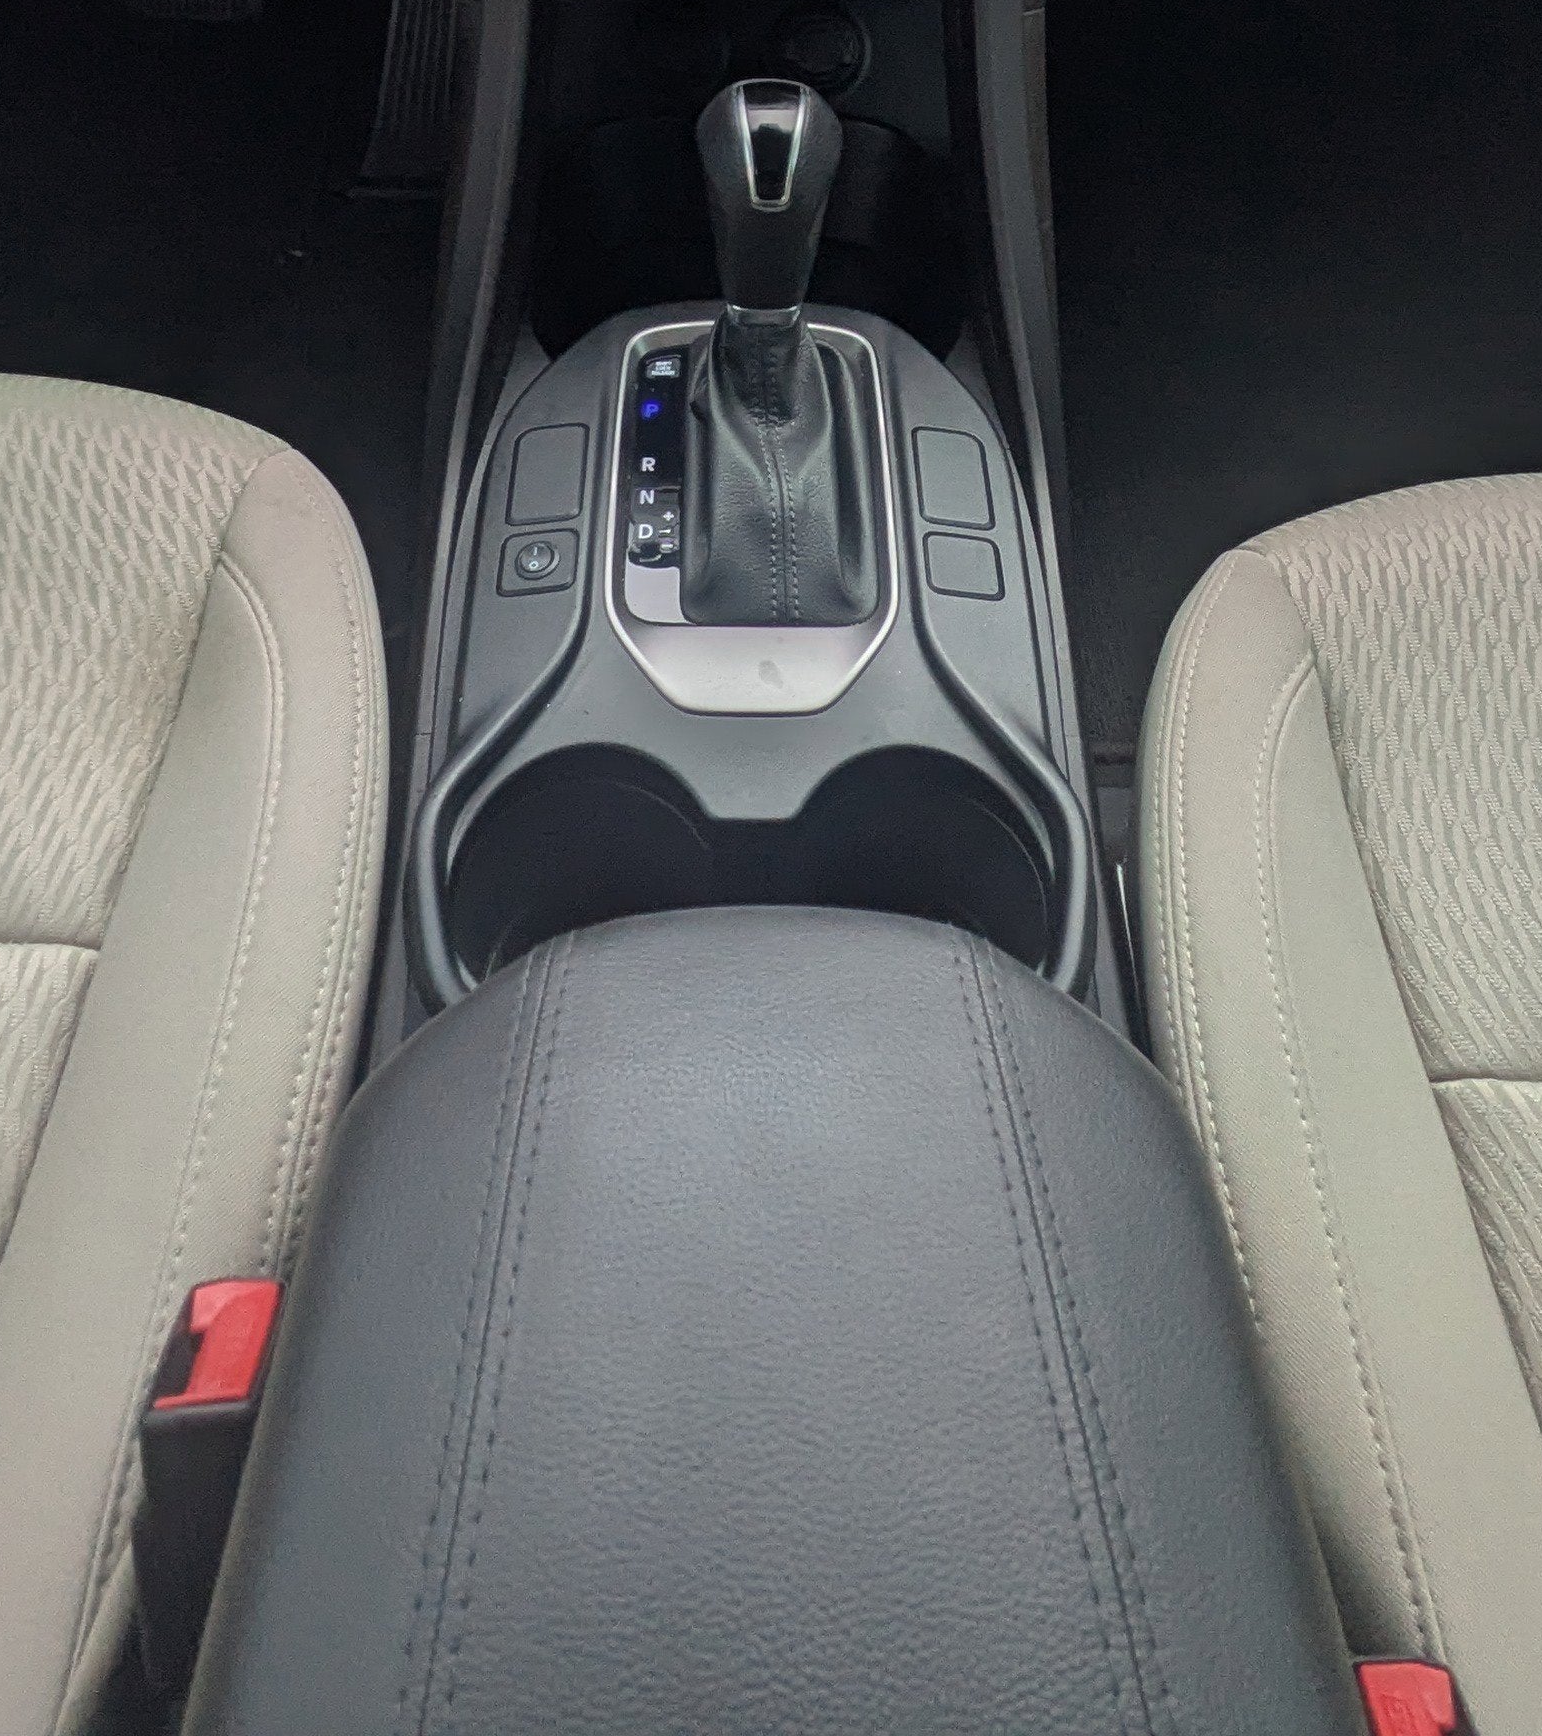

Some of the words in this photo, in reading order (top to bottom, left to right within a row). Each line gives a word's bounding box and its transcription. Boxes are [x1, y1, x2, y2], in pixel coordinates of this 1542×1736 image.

[642, 457, 656, 472] R
[640, 489, 655, 505] N
[639, 524, 653, 539] D
